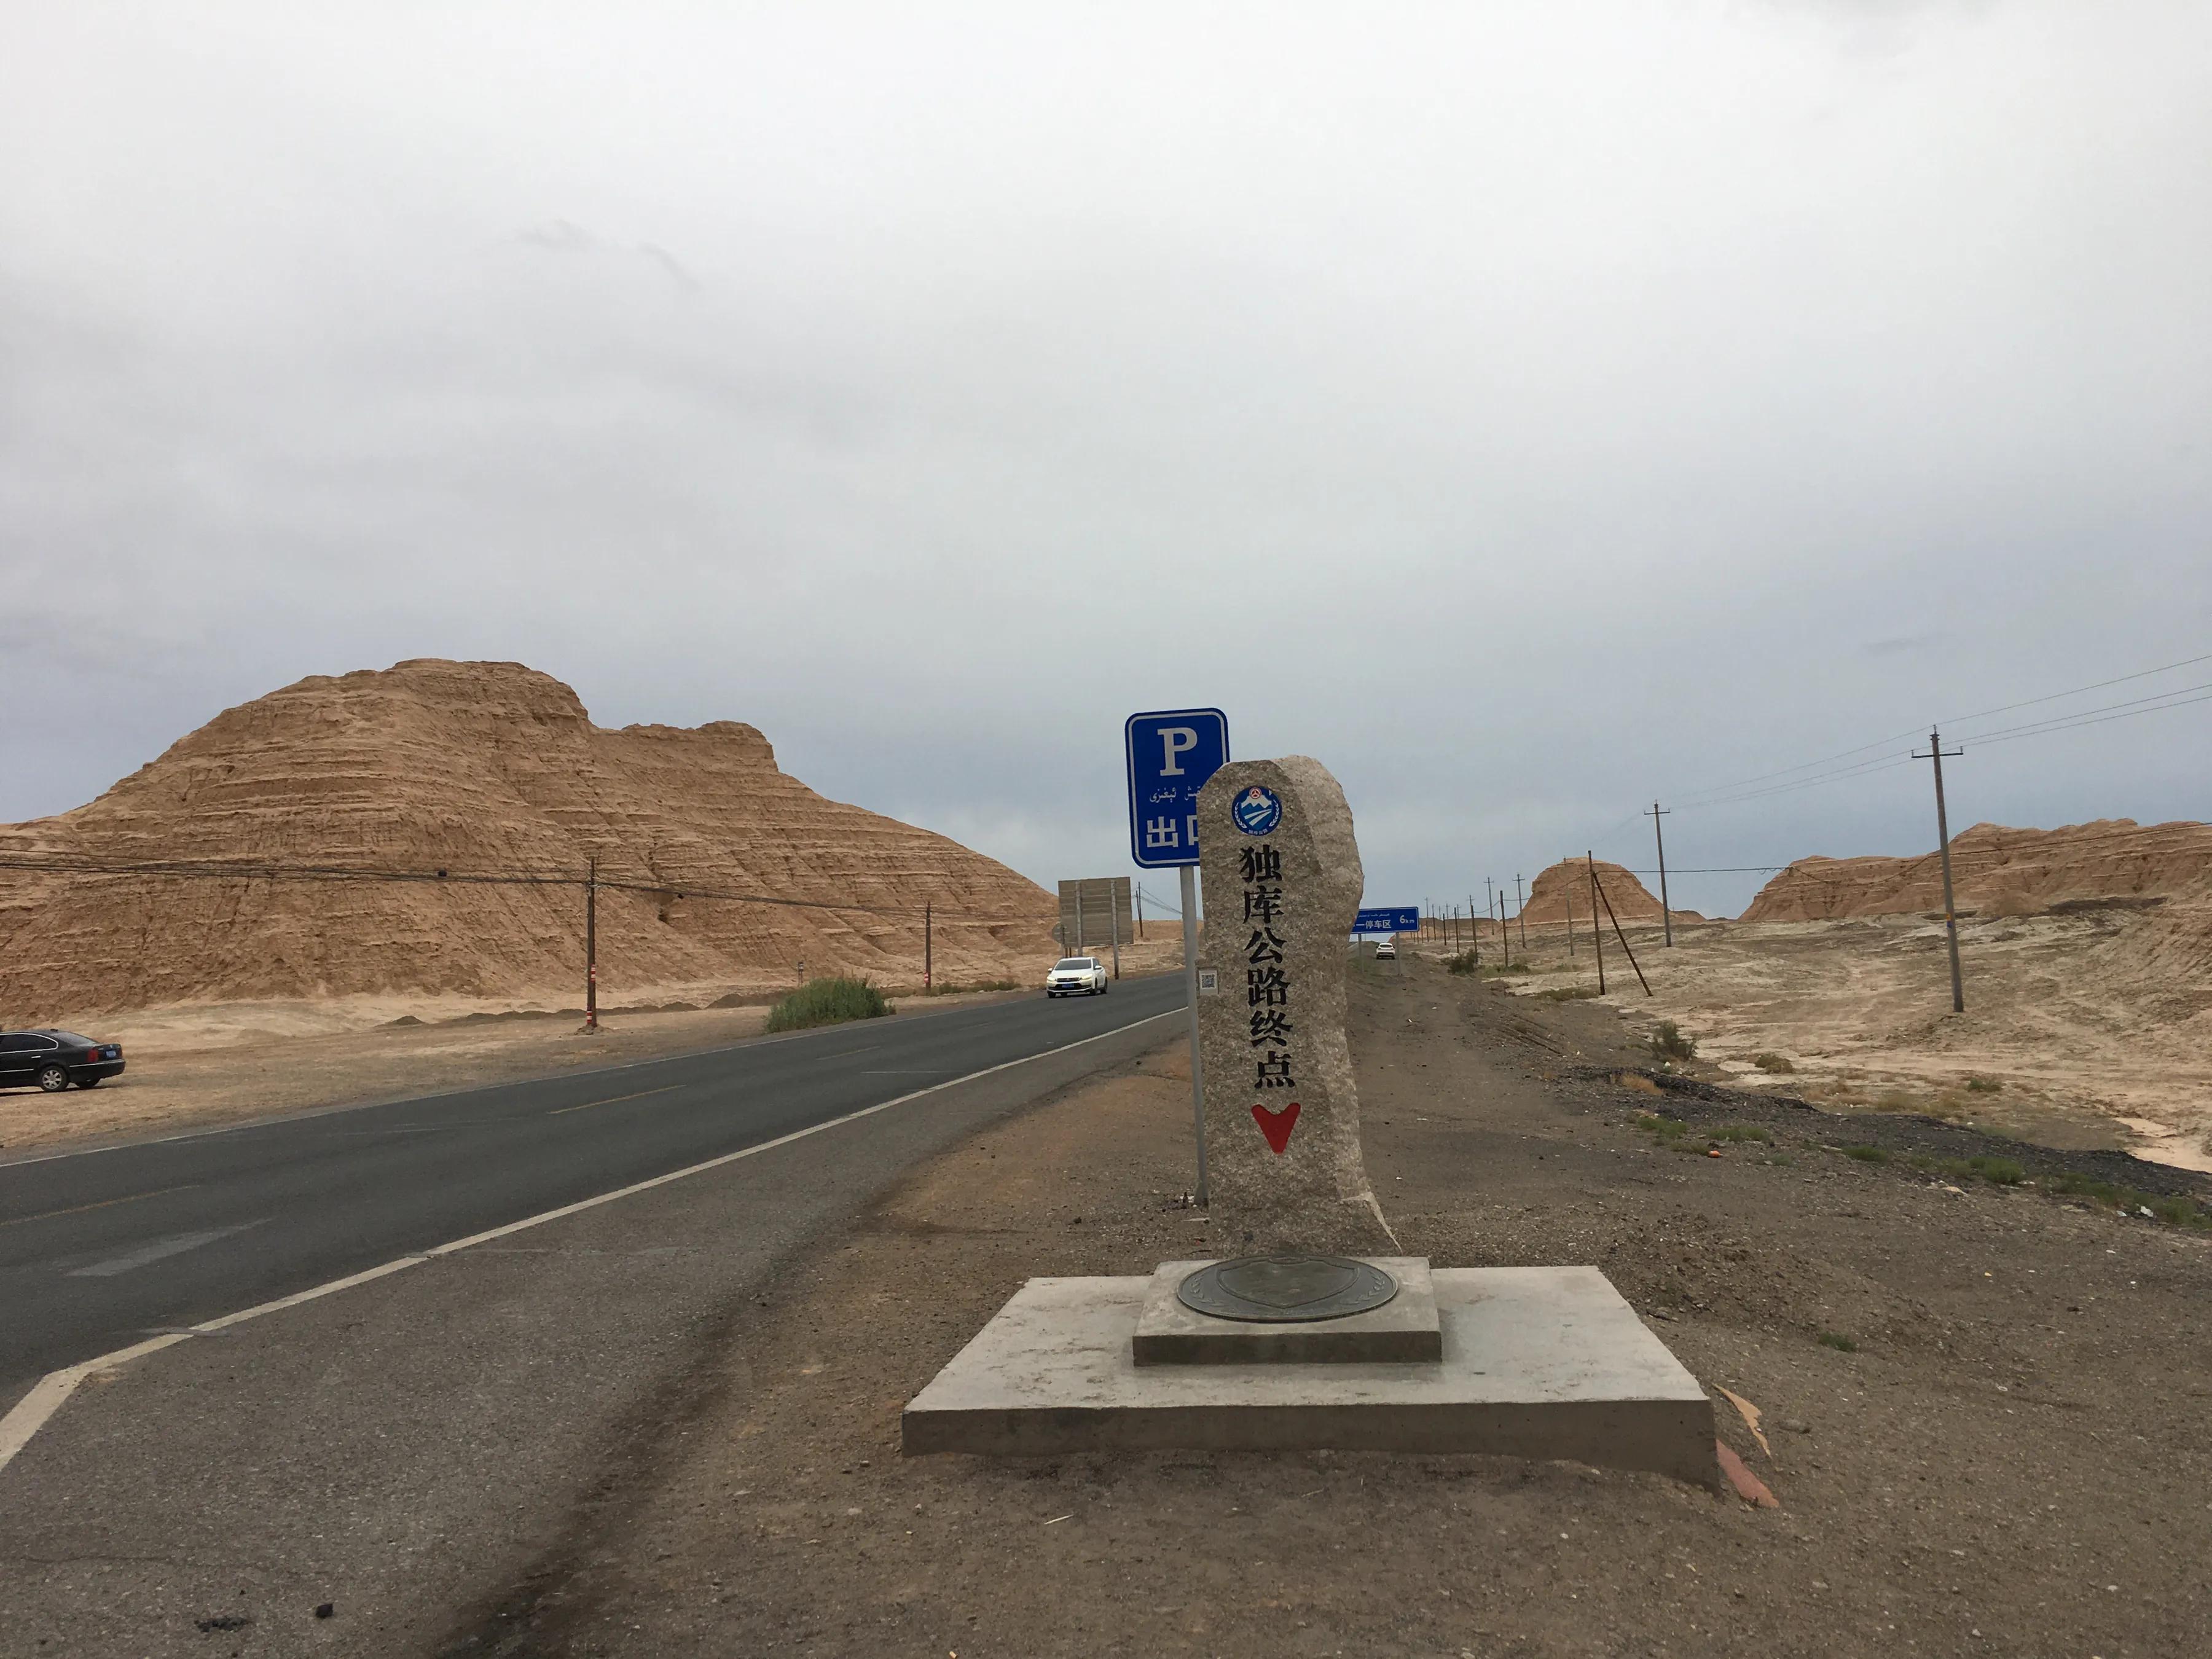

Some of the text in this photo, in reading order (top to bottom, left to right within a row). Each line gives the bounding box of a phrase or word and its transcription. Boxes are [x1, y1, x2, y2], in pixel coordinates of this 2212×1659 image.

[1157, 727, 1198, 777] P
[1353, 919, 1392, 929] 一停车区
[1239, 844, 1295, 1089] 独库公路终点
